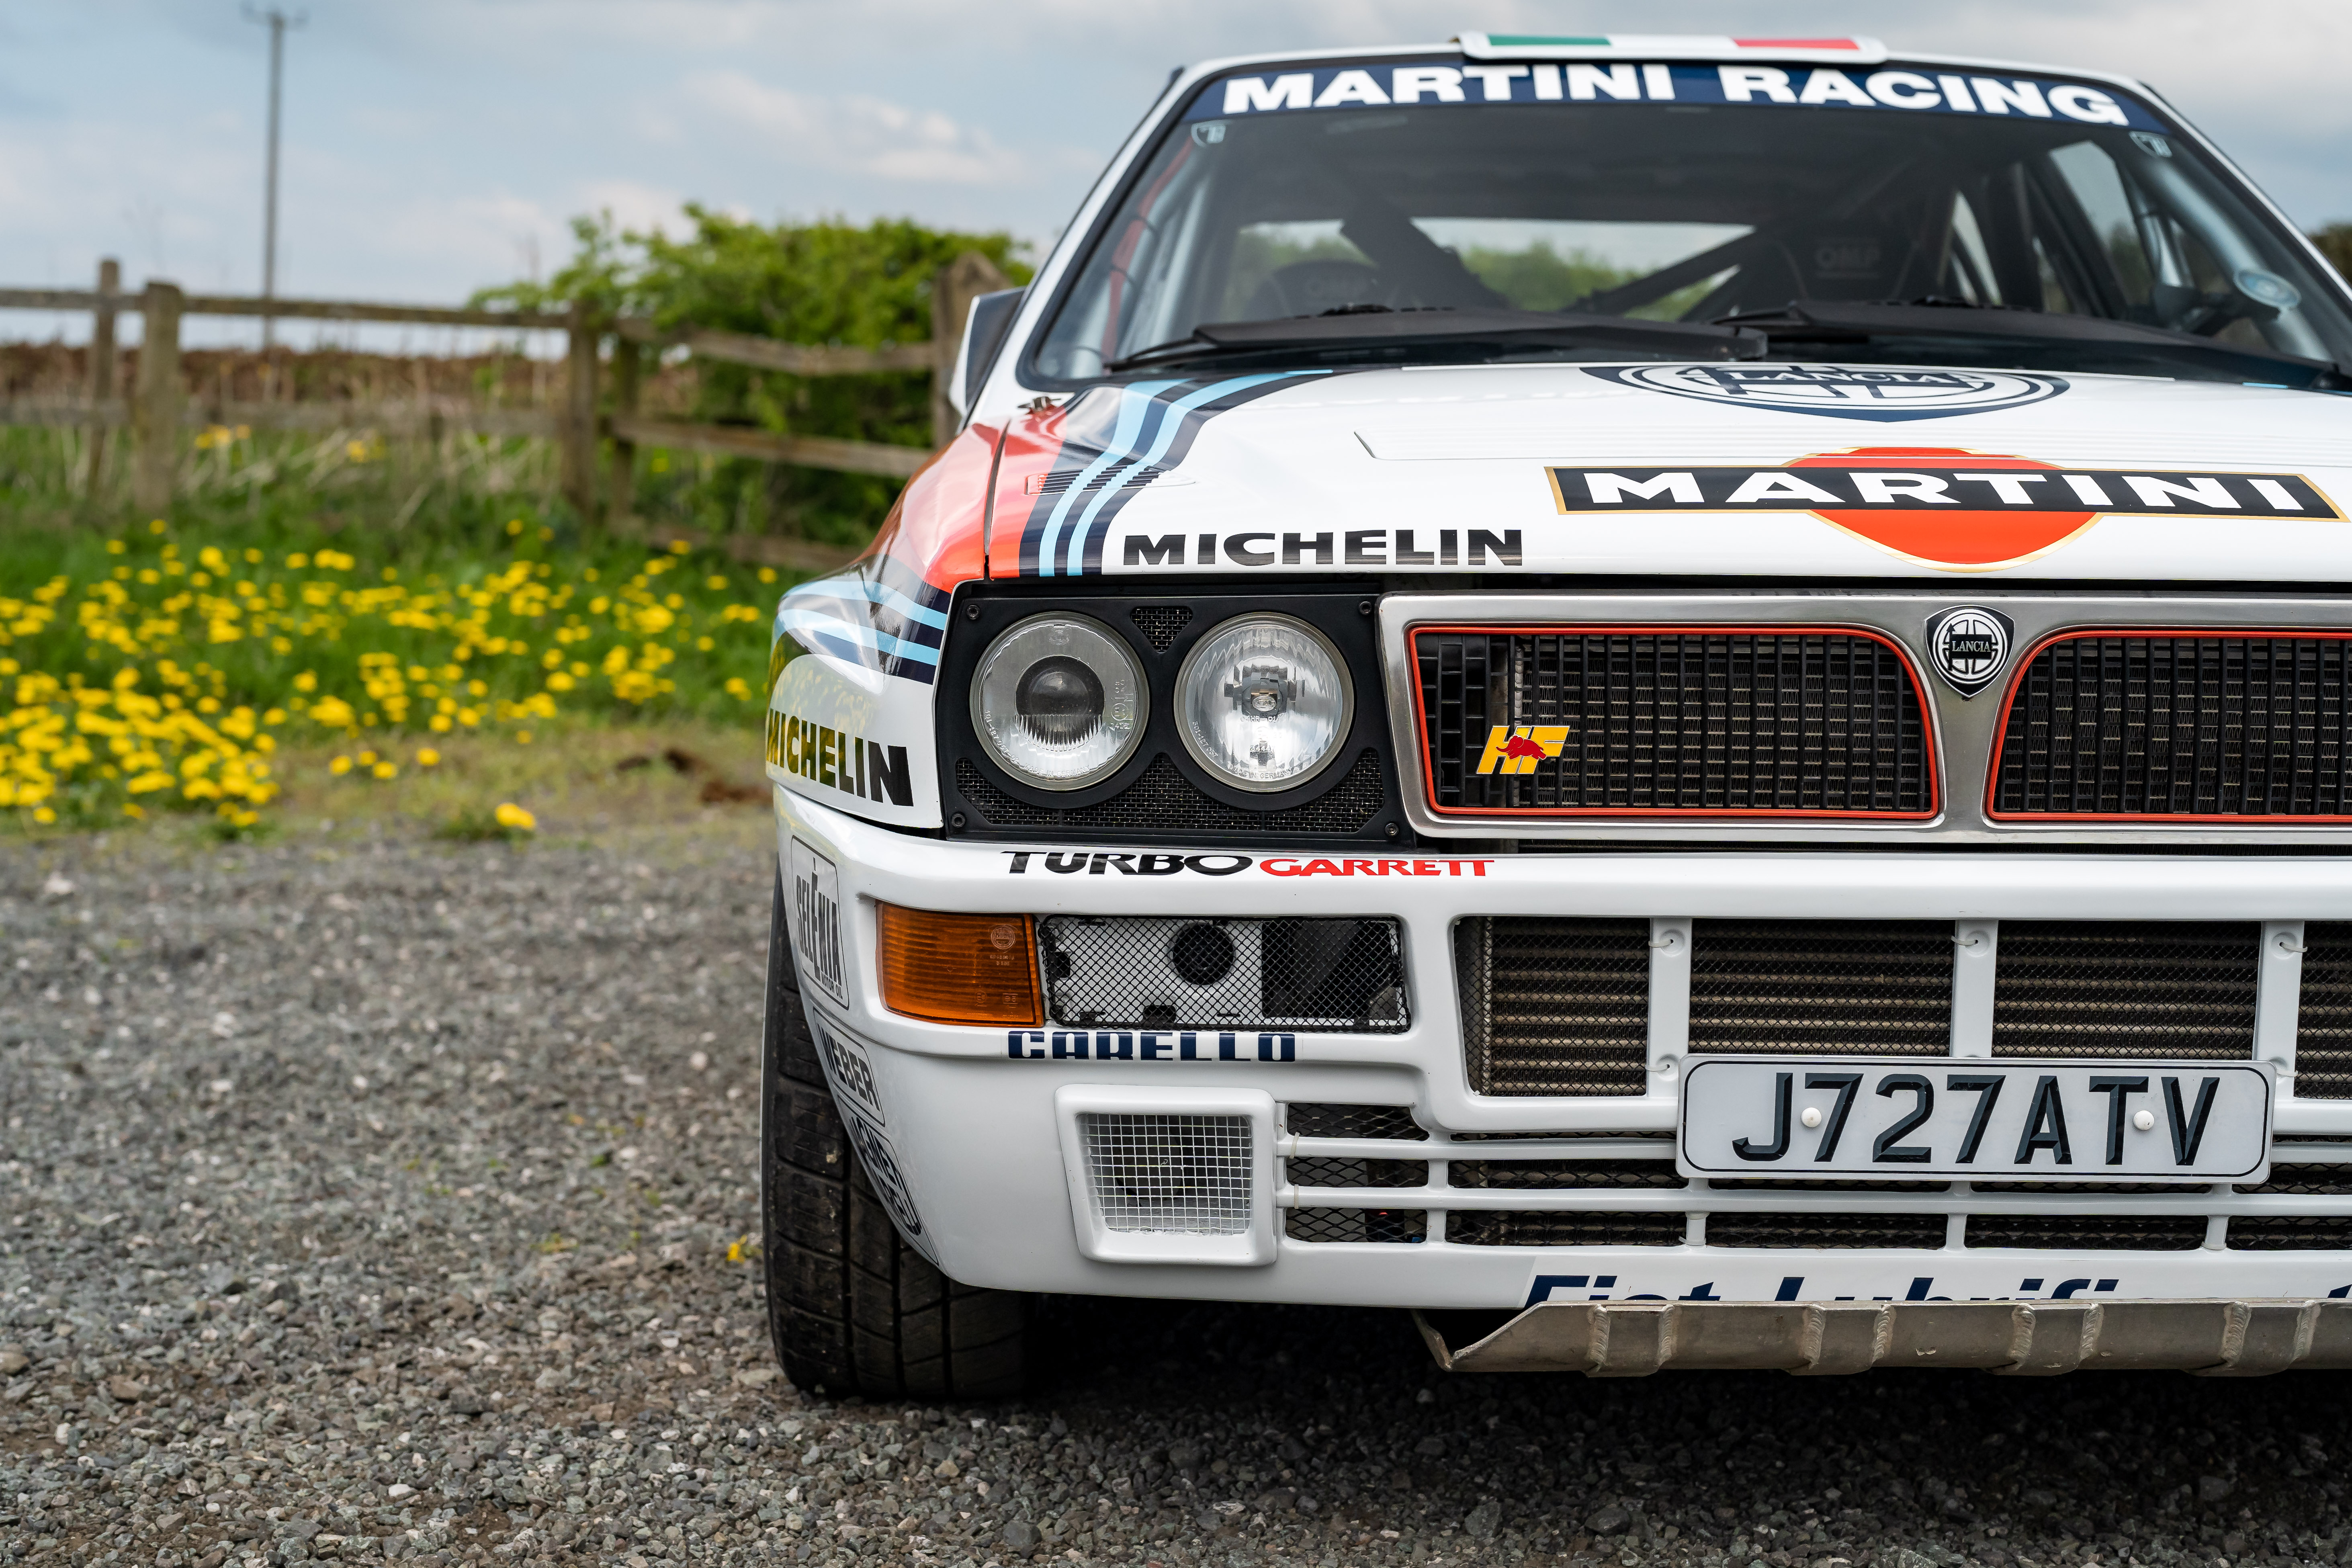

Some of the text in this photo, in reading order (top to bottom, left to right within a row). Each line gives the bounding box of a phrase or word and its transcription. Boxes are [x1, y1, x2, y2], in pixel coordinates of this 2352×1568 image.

[1223, 64, 2130, 126] MARTINI RACING
[1726, 371, 1960, 383] LANCIA
[1584, 471, 2306, 510] MARTINI
[1124, 529, 1522, 566] MICHELIN
[1952, 641, 1991, 652] LANCIA
[766, 708, 914, 807] MICHELIN
[1476, 725, 1570, 774] HF
[1023, 763, 1044, 775] MADE
[1057, 764, 1090, 778] GERMANY
[1001, 851, 1495, 877] TURBO GARRETT
[821, 971, 835, 993] MOTOR
[1008, 1031, 1295, 1062] CARELLO
[817, 1023, 880, 1112] WEBER
[1732, 1073, 2220, 1167] J727ATV
